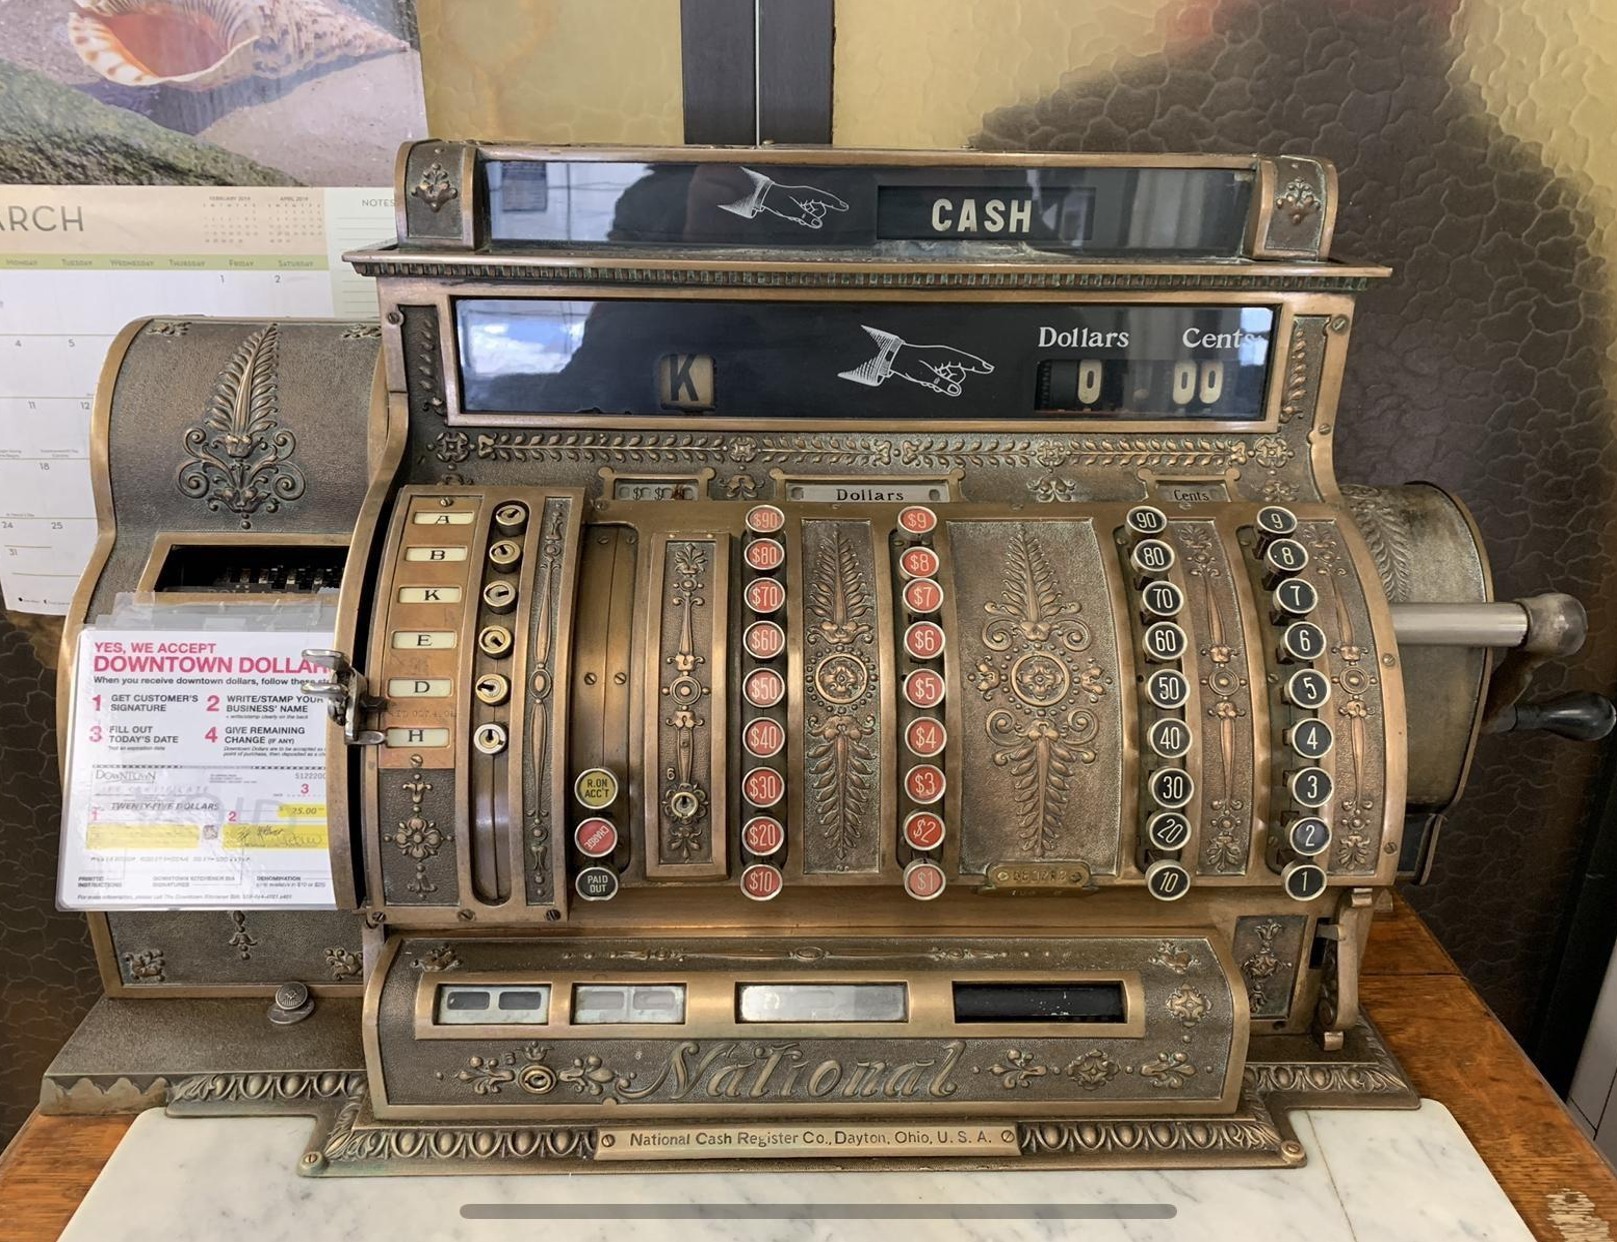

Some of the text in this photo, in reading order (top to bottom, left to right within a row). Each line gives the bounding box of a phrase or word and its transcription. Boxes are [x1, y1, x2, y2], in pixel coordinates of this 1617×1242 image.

[0, 205, 84, 232] RCH
[931, 198, 1032, 233] CASH
[220, 275, 225, 283] 1
[274, 275, 281, 283] 2
[68, 339, 75, 348] 5
[1038, 327, 1130, 348] Dollars
[1182, 328, 1256, 349] Cents
[669, 354, 699, 401] K
[1078, 359, 1102, 405] 0
[1172, 359, 1224, 405] 00
[28, 400, 36, 409] 11
[80, 401, 91, 410] 12
[39, 462, 50, 471] 18
[836, 489, 904, 501] Dollars
[1173, 489, 1209, 501] Cents
[2, 521, 14, 529] 24
[51, 522, 63, 530] 25
[435, 515, 451, 525] A
[753, 512, 778, 529] $90
[908, 512, 927, 529] $9
[1136, 512, 1157, 529] 90
[1271, 513, 1284, 529] 9
[9, 548, 18, 556] 31
[430, 550, 446, 560] B
[752, 547, 777, 565] $80
[1144, 547, 1165, 566] 80
[1281, 547, 1294, 565] 8
[910, 553, 930, 571] $8
[424, 590, 441, 601] K
[752, 586, 778, 606] $70
[913, 586, 933, 605] $7
[1152, 588, 1173, 609] 70
[1290, 585, 1300, 606] 7
[94, 642, 216, 654] YES, WE ACCEPT
[416, 634, 433, 646] E
[751, 629, 778, 651] $60
[914, 630, 935, 651] $6
[1154, 629, 1176, 652] 60
[1299, 629, 1311, 651] 6
[93, 655, 232, 673] DOWNTOWN
[93, 676, 119, 684] When
[226, 677, 259, 686] dollars,
[414, 680, 430, 693] D
[751, 677, 778, 700] $50
[915, 677, 935, 700] $5
[1158, 676, 1179, 700] 50
[1303, 677, 1317, 700] 5
[92, 694, 102, 712] 1
[111, 694, 199, 703] GET CUSTOMER'S
[206, 695, 220, 712] 2
[110, 704, 167, 712] SIGNATURE
[280, 705, 308, 713] NAME
[89, 725, 103, 743] 3
[109, 726, 153, 734] FILL OUT
[109, 735, 151, 743] TODAY'S
[205, 727, 218, 743] 4
[225, 726, 306, 735] GIVE REMAINING
[408, 730, 425, 742] H
[750, 726, 777, 749] $40
[915, 728, 937, 749] $4
[1160, 726, 1180, 750] 40
[1306, 727, 1319, 750] 4
[225, 736, 266, 744] CHANGE
[666, 767, 676, 781] 6
[300, 783, 309, 794] 3
[750, 776, 776, 800] $30
[914, 772, 936, 796] $3
[1162, 776, 1183, 799] 30
[1307, 775, 1318, 799] 3
[176, 803, 219, 811] DOLLARS
[228, 811, 237, 822] 2
[583, 825, 610, 851] CHARGE
[749, 823, 776, 847] $20
[913, 818, 936, 843] $2
[1157, 818, 1184, 844] 20
[1305, 824, 1315, 847] 2
[587, 875, 609, 884] PAID
[589, 884, 607, 893] OUT
[749, 871, 773, 892] $10
[917, 871, 934, 892] $1
[1159, 871, 1179, 893] 10
[1301, 871, 1308, 892] 1
[614, 1040, 966, 1100] National
[629, 1131, 992, 1148] National Cash Register Co., Dayton, Ohio, U. S. A.
